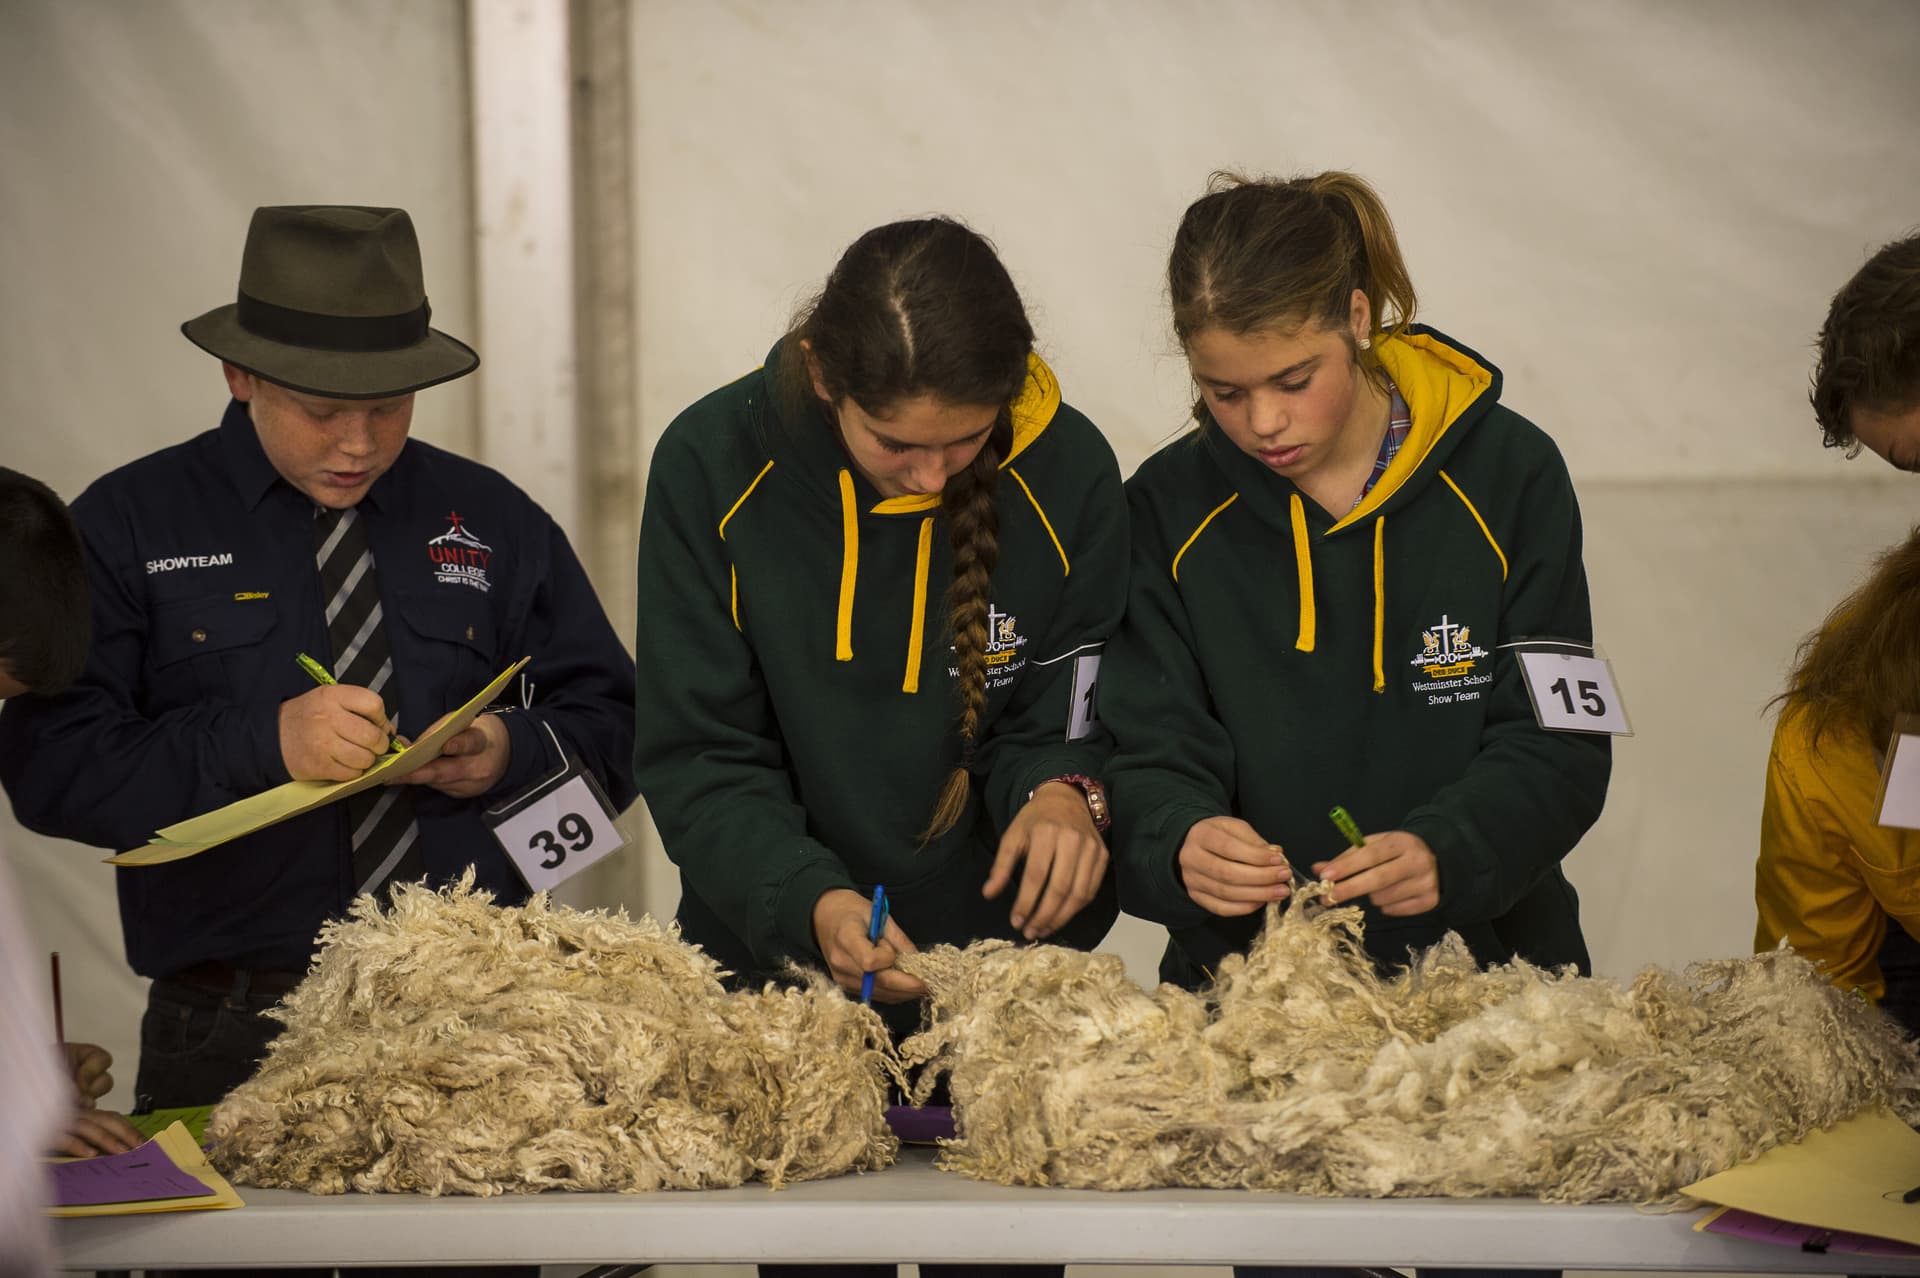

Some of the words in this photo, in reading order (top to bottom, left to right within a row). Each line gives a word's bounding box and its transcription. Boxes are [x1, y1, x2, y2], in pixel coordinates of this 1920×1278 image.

[146, 553, 233, 574] SHOWTEAM
[428, 546, 492, 569] UNITY
[441, 563, 487, 580] COLLEGE
[948, 666, 1003, 677] Wester
[1412, 679, 1462, 692] Westminster
[1463, 672, 1493, 686] School
[1428, 695, 1453, 705] Show
[1454, 691, 1480, 702] Team
[1550, 677, 1606, 717] 15
[528, 812, 594, 870] 39
